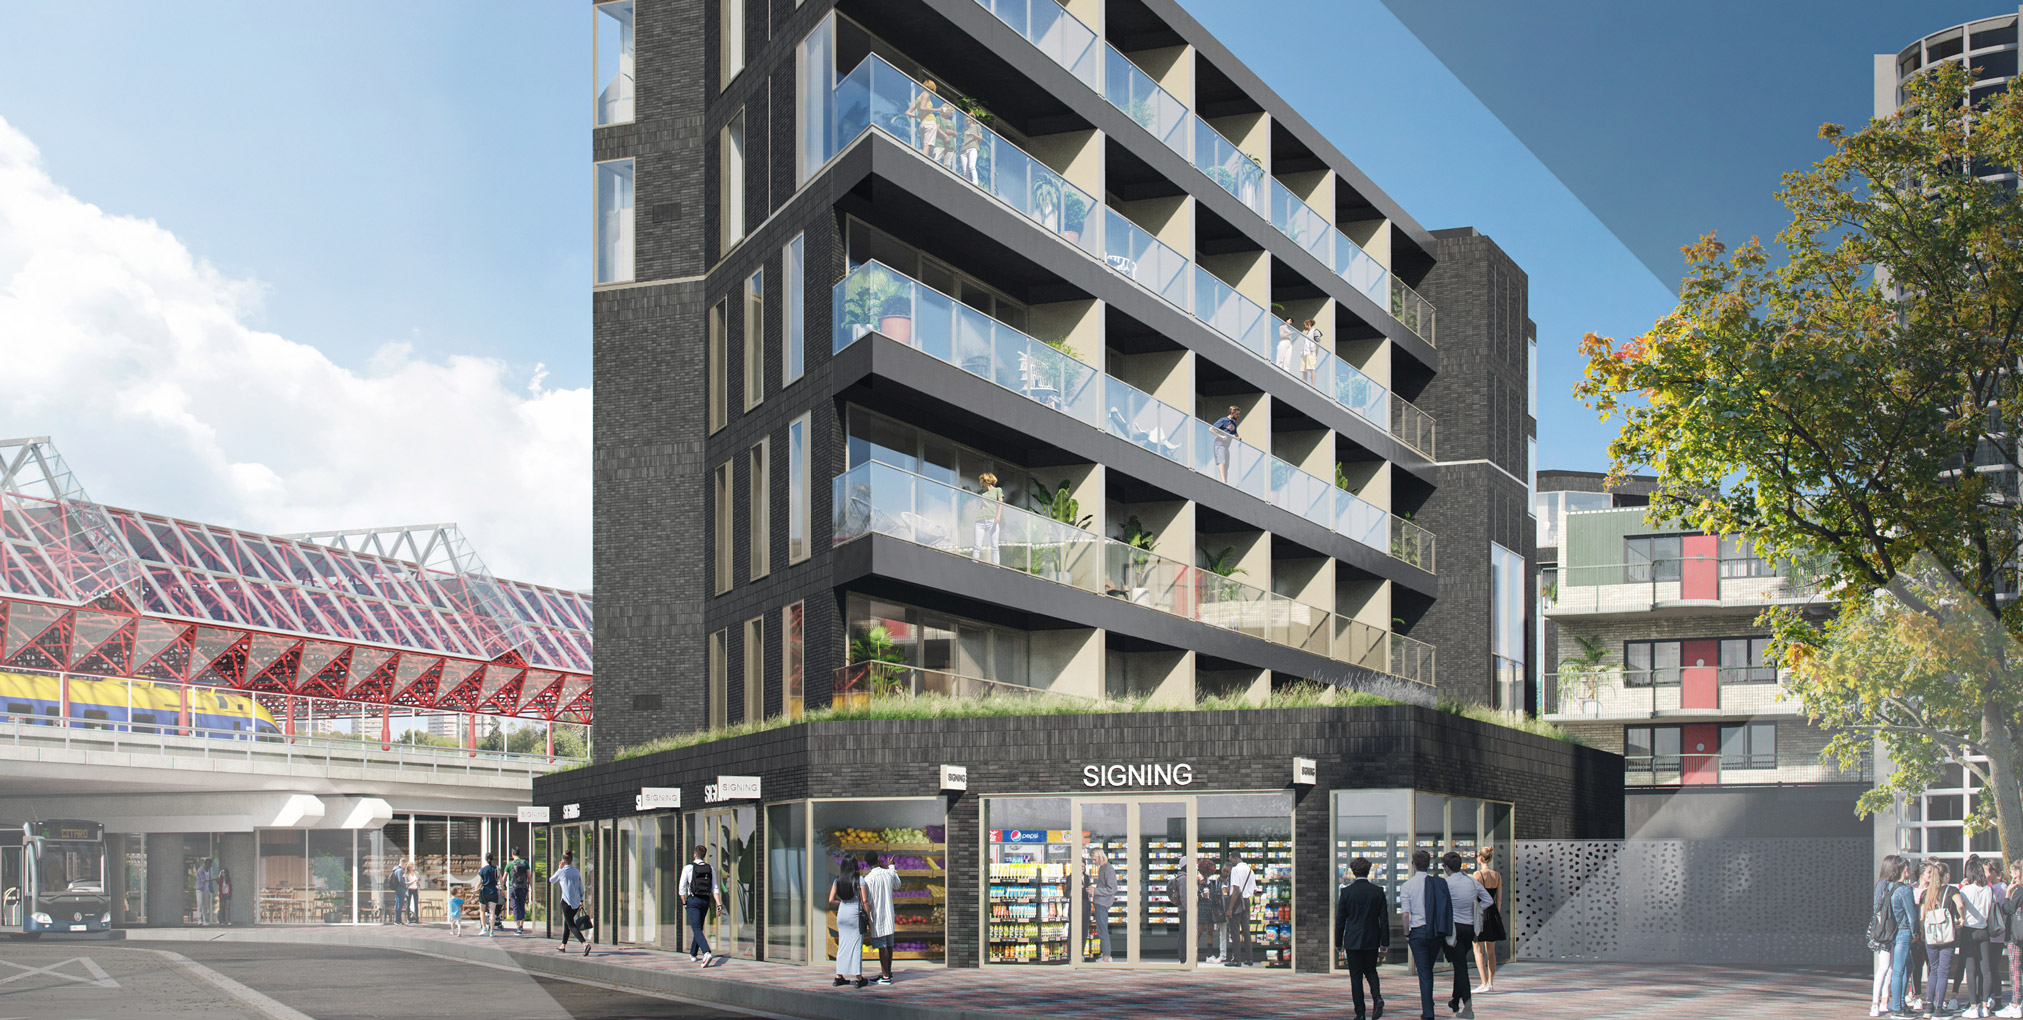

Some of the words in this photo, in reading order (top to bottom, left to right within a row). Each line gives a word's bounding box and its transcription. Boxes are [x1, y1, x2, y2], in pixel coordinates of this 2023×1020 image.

[1083, 763, 1192, 787] SIGNING
[722, 783, 758, 792] SIGNING
[645, 794, 678, 802] SIGNING
[61, 829, 88, 838] CITARO
